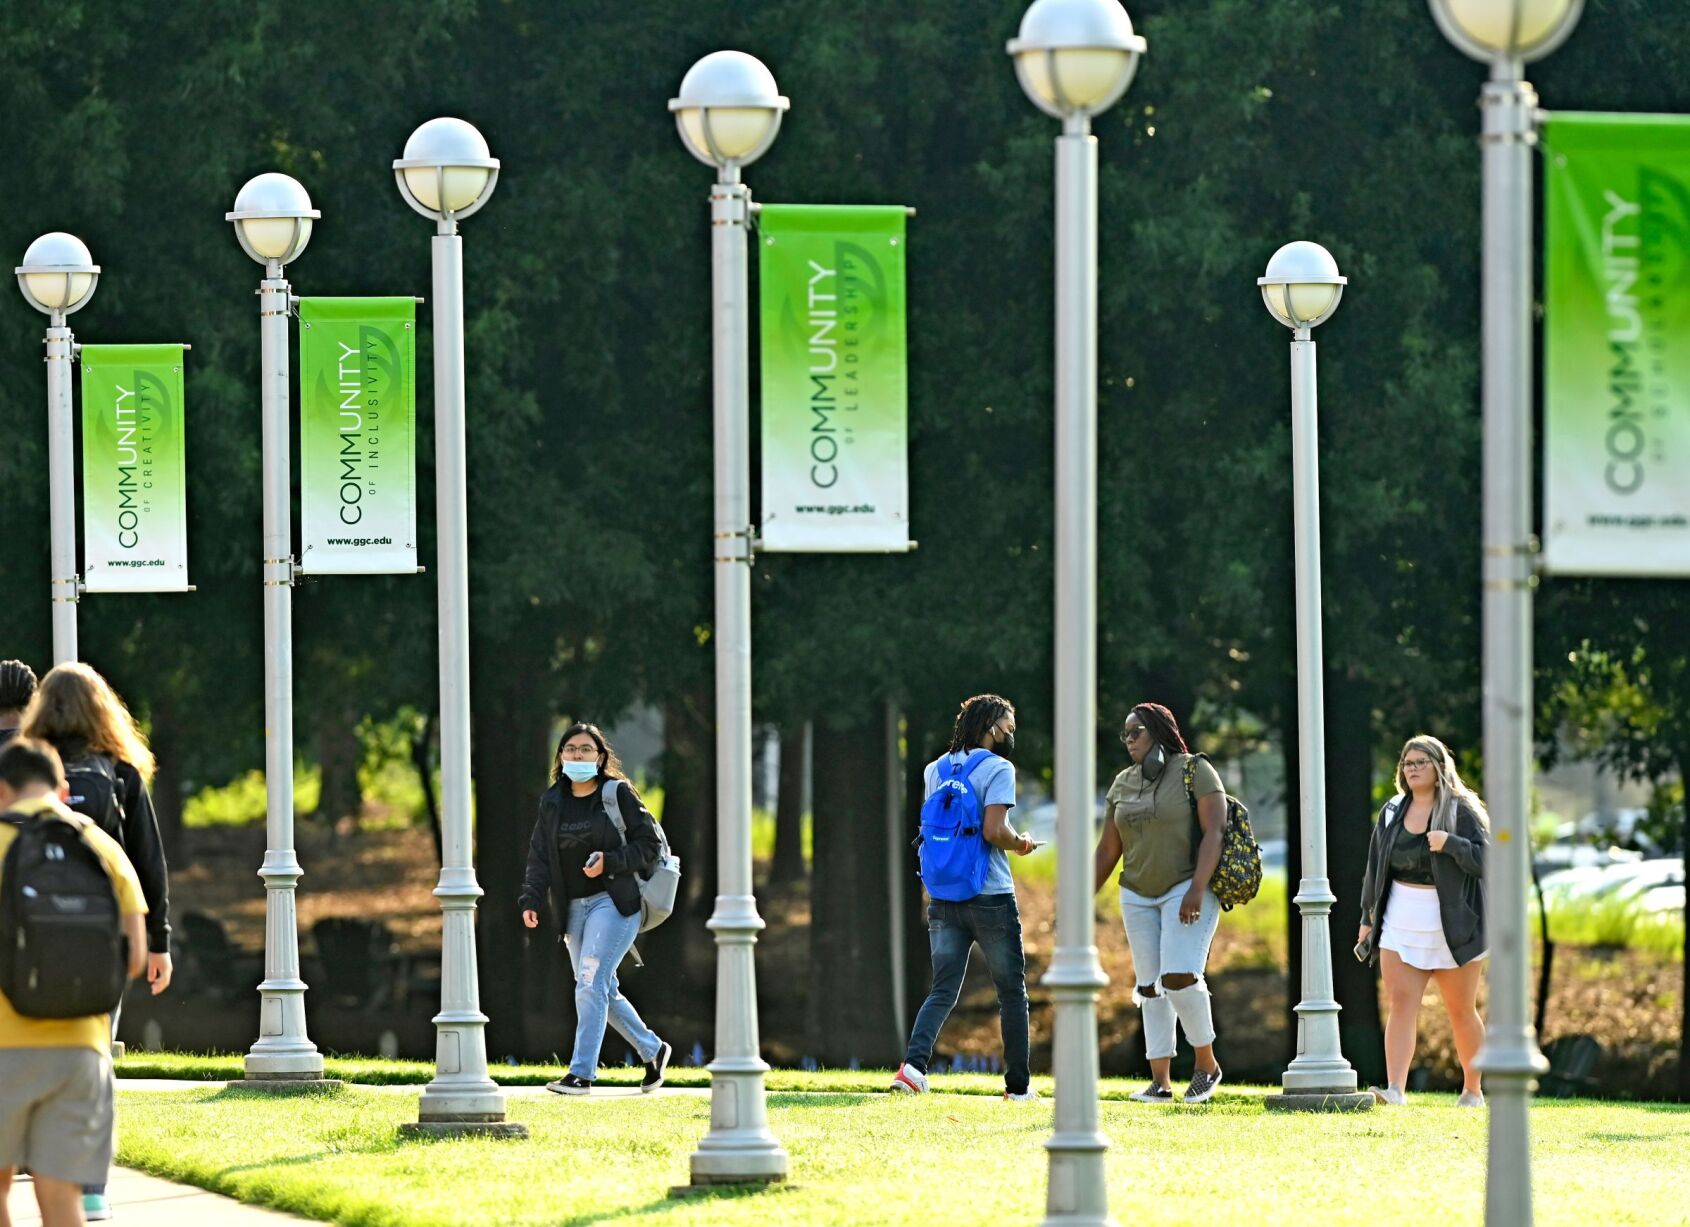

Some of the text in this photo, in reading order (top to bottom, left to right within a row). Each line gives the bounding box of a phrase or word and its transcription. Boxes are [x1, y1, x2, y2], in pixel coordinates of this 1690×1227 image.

[367, 341, 379, 495] OF INCLUSIVITY
[808, 259, 838, 488] COMMUNITY
[844, 259, 859, 444] OF LEADERSHIP
[1604, 189, 1645, 496] COMMUNITY
[115, 384, 138, 548] COMMUNITY
[141, 384, 153, 513] OF CREATIVITY
[338, 341, 362, 525] COMMUNITY
[795, 503, 875, 515] www.ggc.edu
[107, 558, 165, 569] www.ggc.edu
[327, 535, 392, 547] www.ggc.edu
